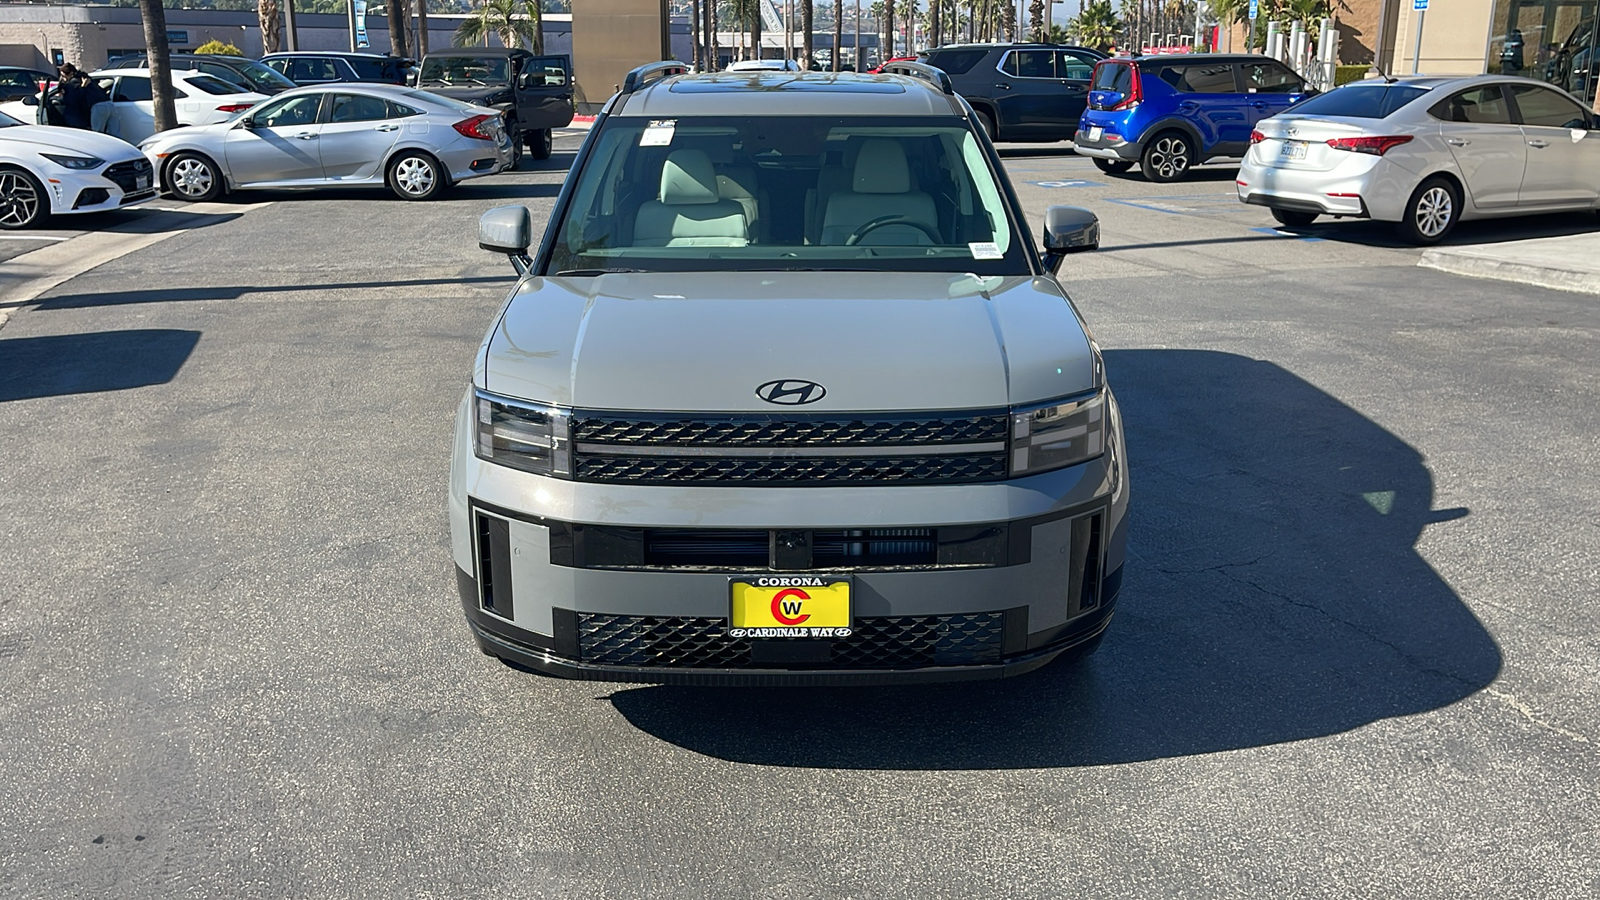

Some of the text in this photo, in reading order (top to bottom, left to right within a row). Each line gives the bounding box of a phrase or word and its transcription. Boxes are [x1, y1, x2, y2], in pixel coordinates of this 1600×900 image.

[758, 577, 823, 586] CORONA
[782, 601, 802, 615] W
[747, 628, 834, 637] CARDINALE WAY
